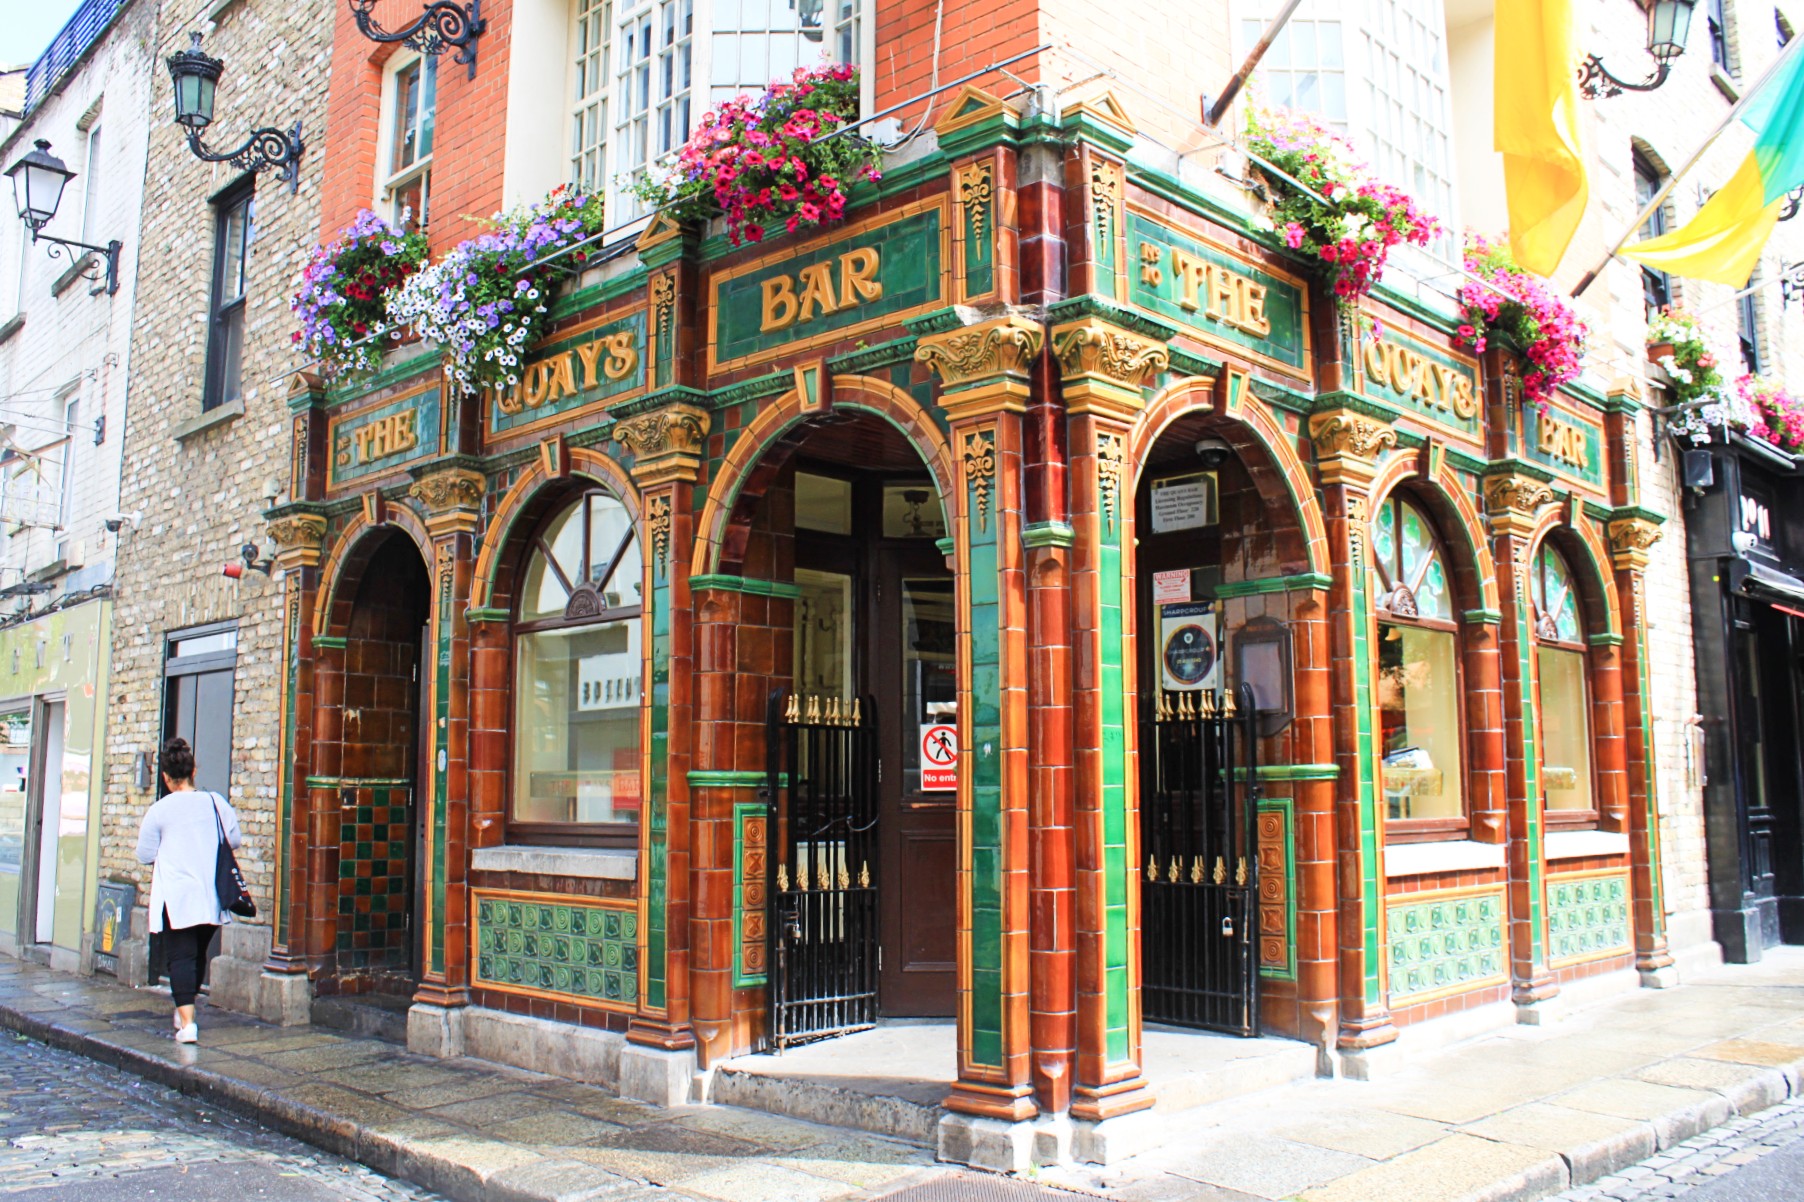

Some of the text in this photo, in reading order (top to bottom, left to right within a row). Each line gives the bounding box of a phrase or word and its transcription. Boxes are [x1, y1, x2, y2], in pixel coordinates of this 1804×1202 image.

[1140, 264, 1163, 287] 10
[355, 247, 883, 465] THE QUAYS BAR
[1172, 246, 1588, 471] THE QUAYS BAR
[924, 774, 957, 782] No entr
